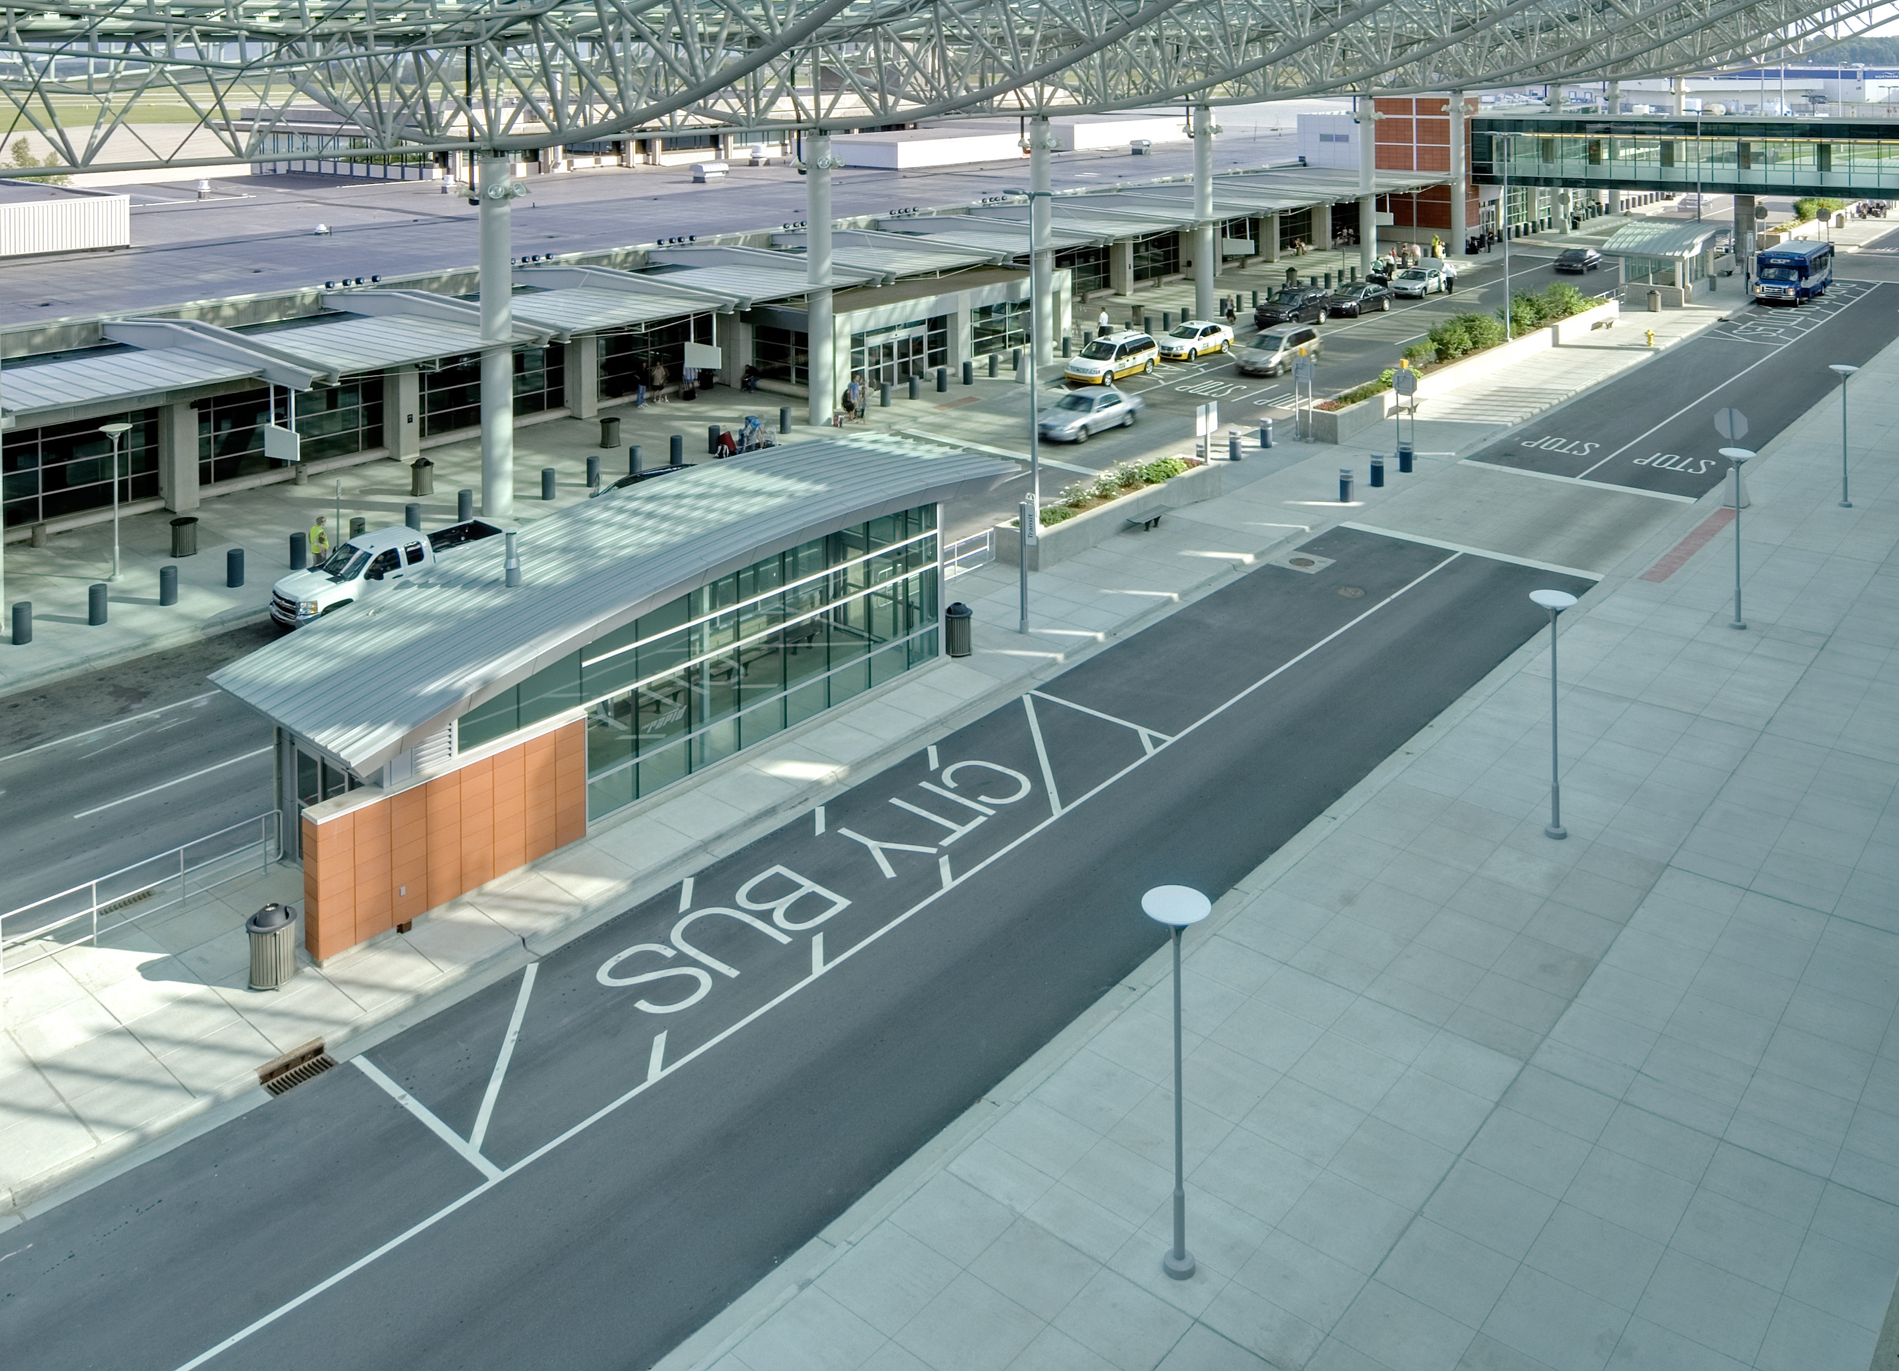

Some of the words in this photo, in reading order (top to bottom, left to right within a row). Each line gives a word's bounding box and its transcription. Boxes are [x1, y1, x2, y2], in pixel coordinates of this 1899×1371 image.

[1175, 380, 1247, 397] STOP
[1253, 393, 1309, 411] TOP
[1520, 436, 1600, 456] STOP
[1633, 453, 1716, 474] STOP
[837, 760, 1031, 879] CITY
[596, 865, 852, 1014] BUS
